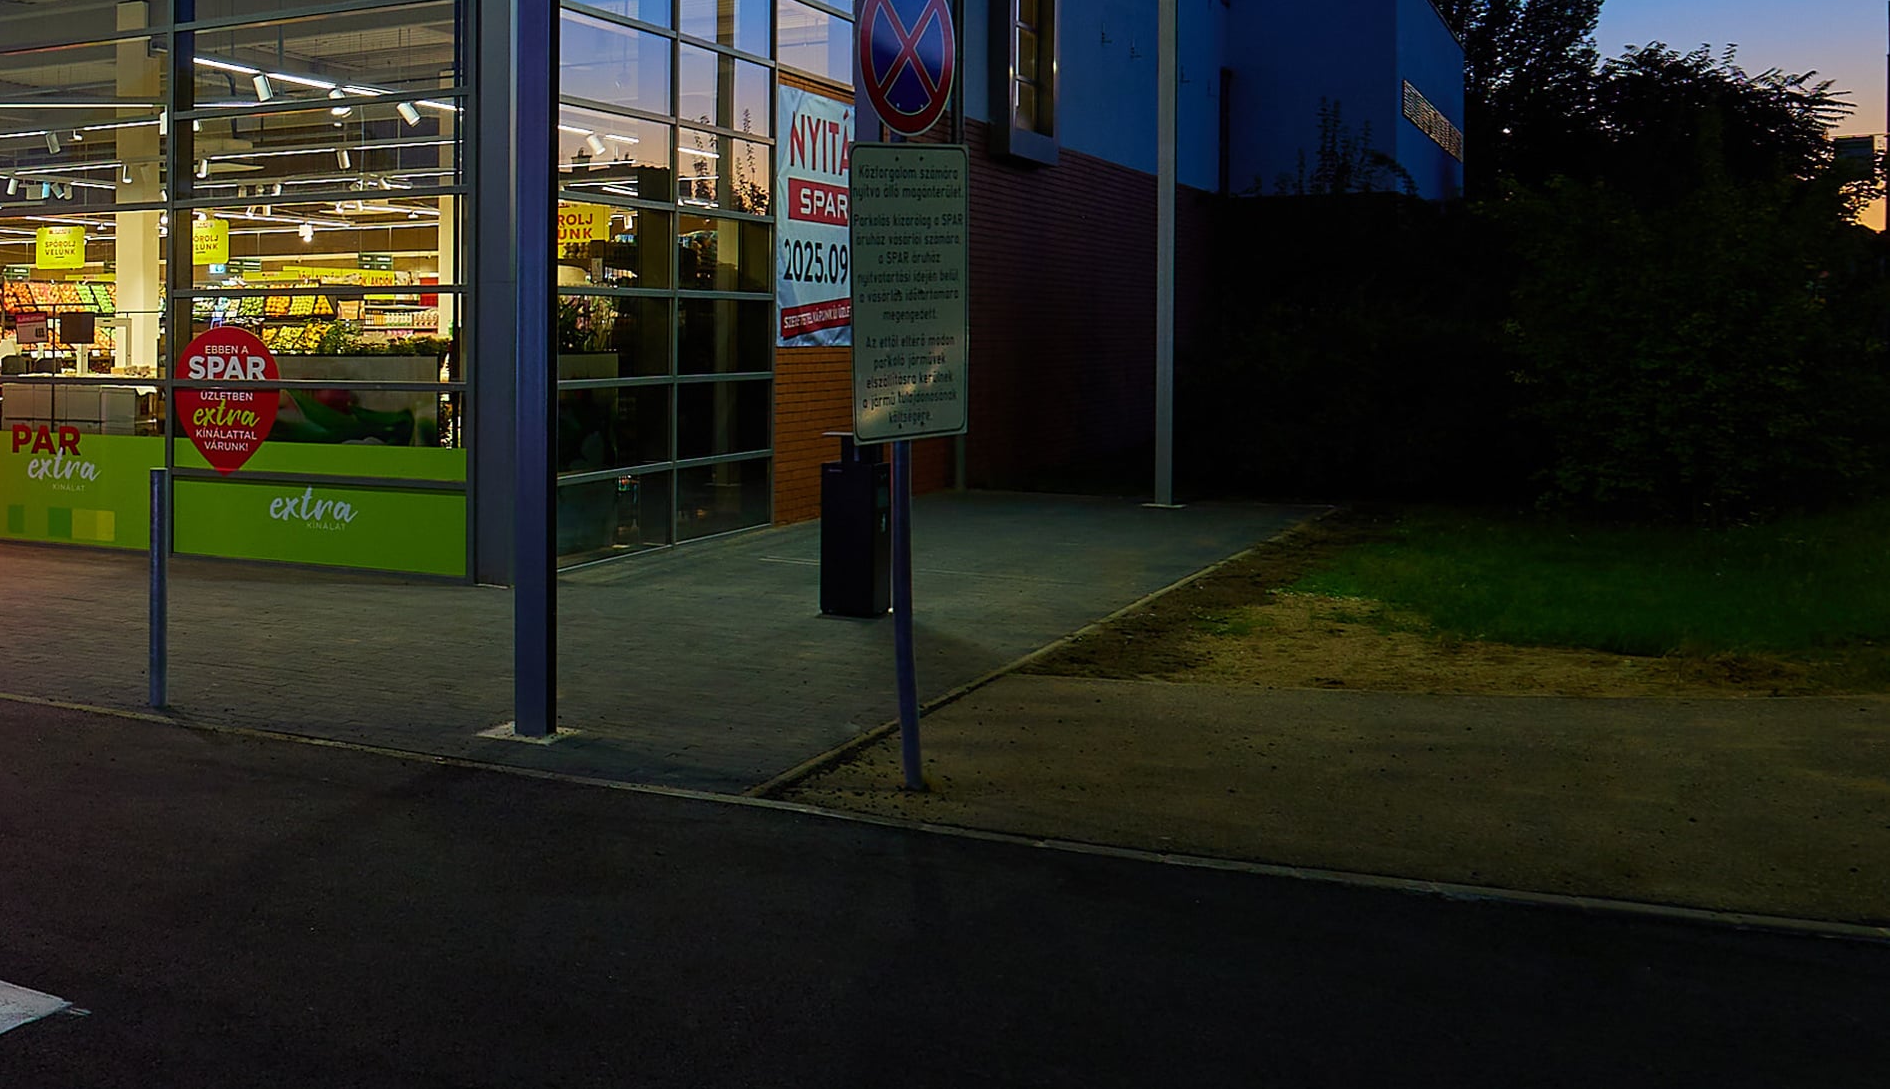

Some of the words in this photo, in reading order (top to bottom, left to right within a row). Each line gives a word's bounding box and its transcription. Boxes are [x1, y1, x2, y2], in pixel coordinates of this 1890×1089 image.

[858, 165, 917, 182] Közforgalom
[920, 165, 959, 180] számára
[853, 184, 880, 201] nyitva
[883, 183, 899, 198] álló
[800, 187, 848, 220] SPAR
[853, 214, 890, 227] Parkolás
[893, 214, 931, 229] kizárólag
[941, 214, 963, 226] SPAR
[856, 231, 886, 246] áruház
[783, 238, 849, 284] 2025.09
[878, 254, 883, 264] a
[886, 251, 909, 264] SPAR
[911, 250, 941, 264] áruház
[859, 293, 865, 303] a
[867, 289, 902, 303] vásárlás
[866, 336, 877, 348] Az
[928, 333, 955, 346] módon
[205, 345, 238, 354] EBBEN
[241, 345, 249, 354] A
[188, 355, 266, 380] SPAR
[874, 353, 905, 371] parkoló
[200, 390, 253, 401] ÜZLETBEN
[862, 399, 868, 408] a
[193, 399, 260, 427] extra
[12, 424, 81, 456] PAR
[195, 427, 257, 440] KÍNÁLATTAL
[204, 440, 249, 451] VÁRUNK!
[28, 446, 102, 482] extra
[270, 485, 358, 523] extra
